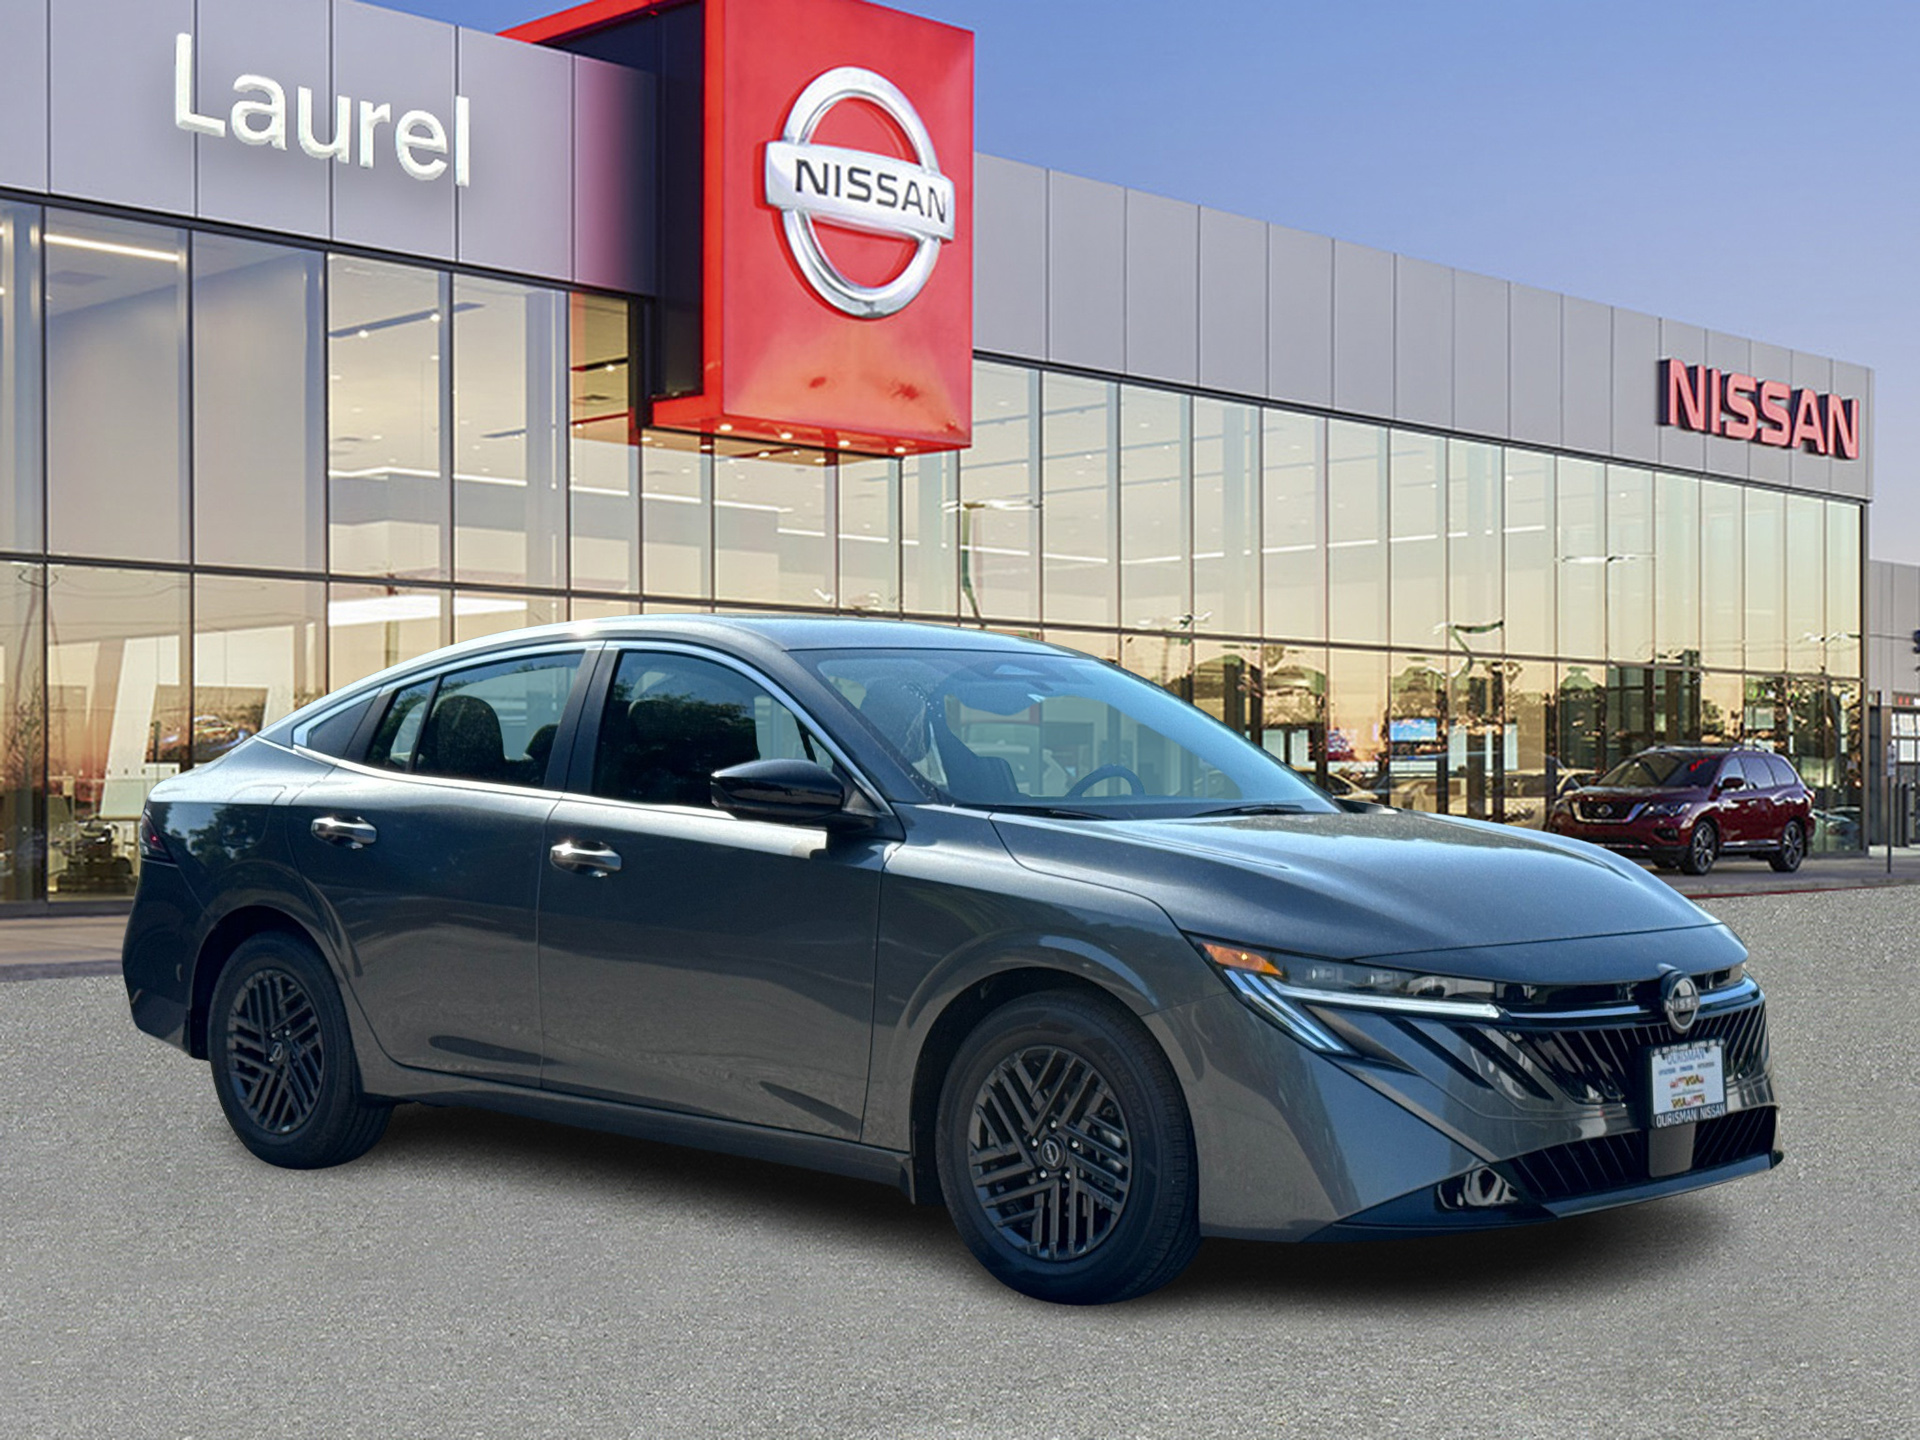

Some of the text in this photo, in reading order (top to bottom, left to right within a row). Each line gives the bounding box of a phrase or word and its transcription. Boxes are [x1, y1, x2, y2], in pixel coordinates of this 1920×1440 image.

[175, 32, 470, 188] Laurel
[795, 158, 948, 224] NISSAN
[1658, 357, 1860, 460] NISSAN
[1656, 1103, 1726, 1128] OURISMAN NISSAN
